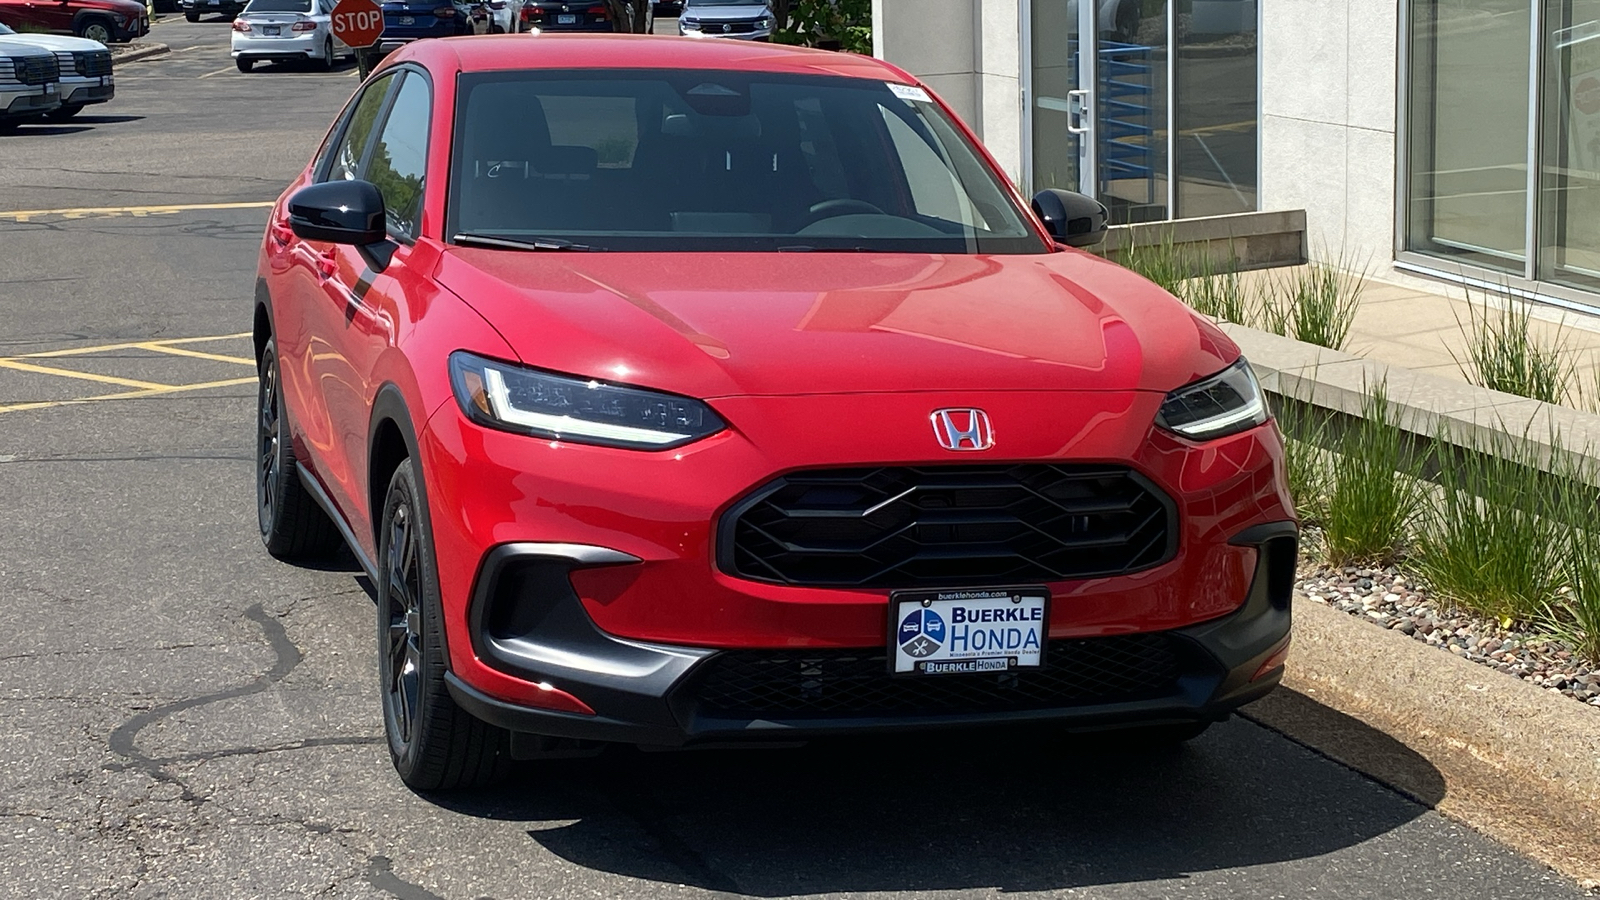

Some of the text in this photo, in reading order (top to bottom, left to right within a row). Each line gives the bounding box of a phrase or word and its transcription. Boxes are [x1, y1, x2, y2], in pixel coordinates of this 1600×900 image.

[334, 10, 380, 33] STOP
[938, 591, 1008, 600] buerklehonda.com
[951, 606, 1042, 624] BUERKLE
[950, 624, 1040, 652] HONDA
[926, 660, 1006, 673] BUERKLE HONDA
